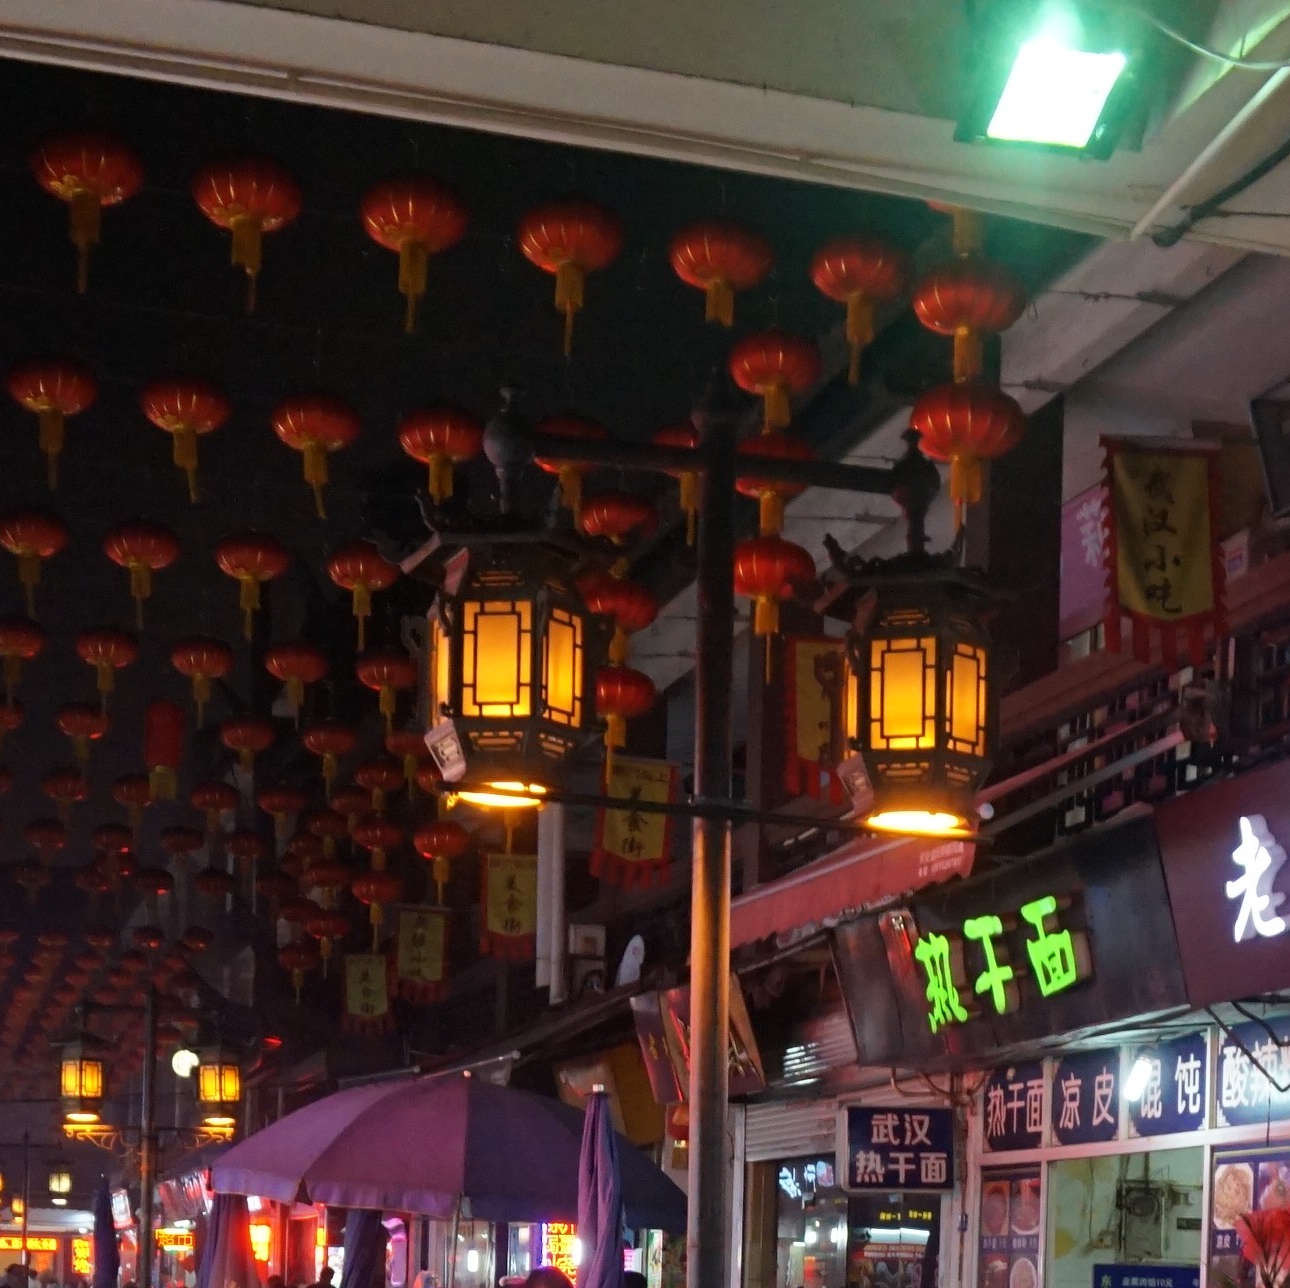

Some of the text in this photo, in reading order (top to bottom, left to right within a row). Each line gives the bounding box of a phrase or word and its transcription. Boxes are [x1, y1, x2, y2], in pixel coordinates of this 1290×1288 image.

[915, 895, 1077, 1034] 热干面
[870, 1112, 932, 1146] 武汉
[987, 1078, 1044, 1138] 热干面
[1059, 1067, 1116, 1130] 凉皮
[855, 1150, 948, 1185] 热干面
